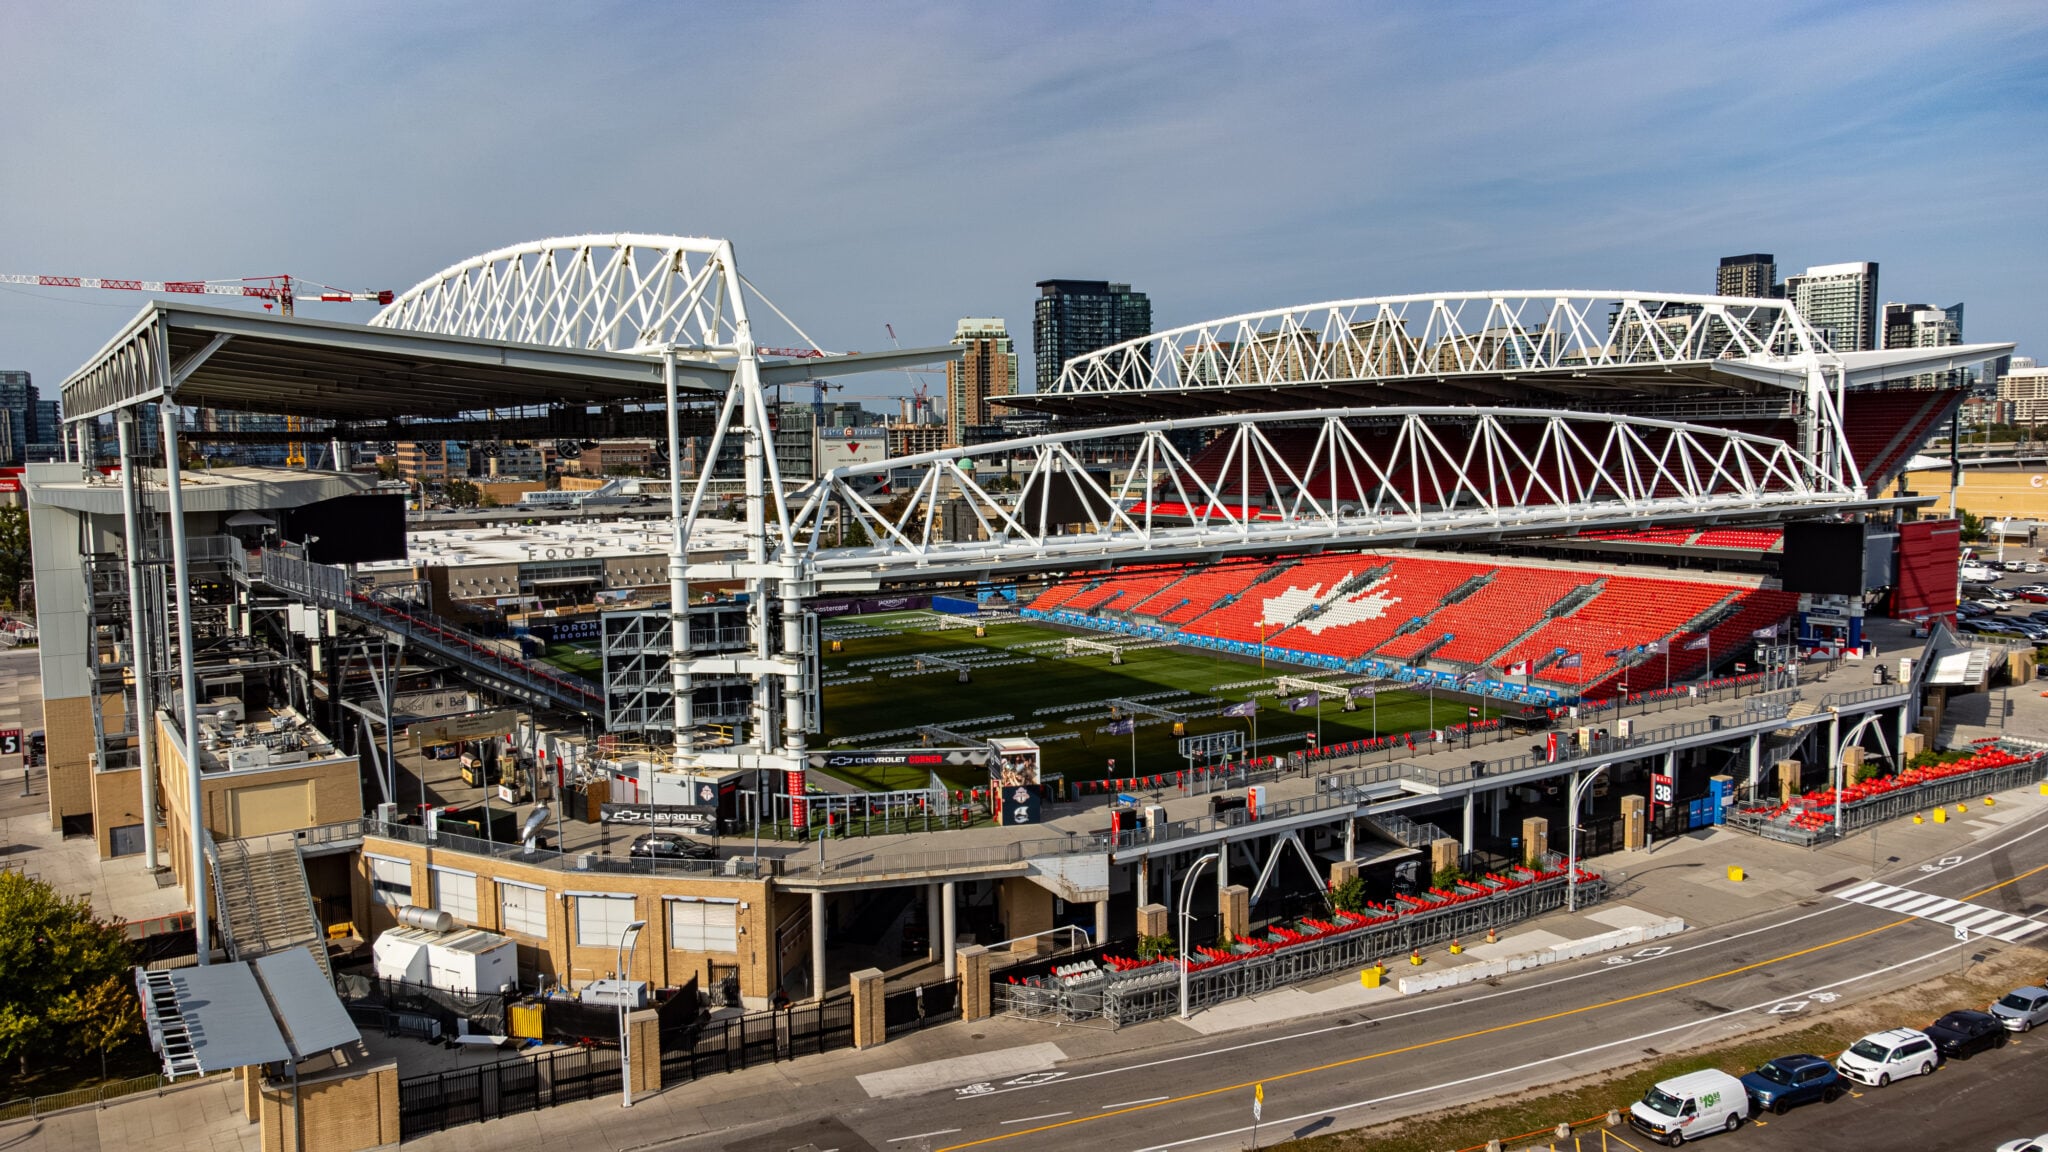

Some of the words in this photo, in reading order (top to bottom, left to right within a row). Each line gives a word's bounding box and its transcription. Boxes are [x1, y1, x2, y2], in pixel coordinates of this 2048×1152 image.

[528, 546, 595, 561] FOOD
[552, 621, 602, 633] TORON
[450, 695, 467, 707] Bell
[5, 736, 16, 753] 5
[855, 756, 906, 764] CHEVROLET
[908, 755, 943, 764] CORNER
[1656, 776, 1671, 784] GATE
[1655, 784, 1671, 802] 3B
[643, 812, 703, 821] CHEVROLET
